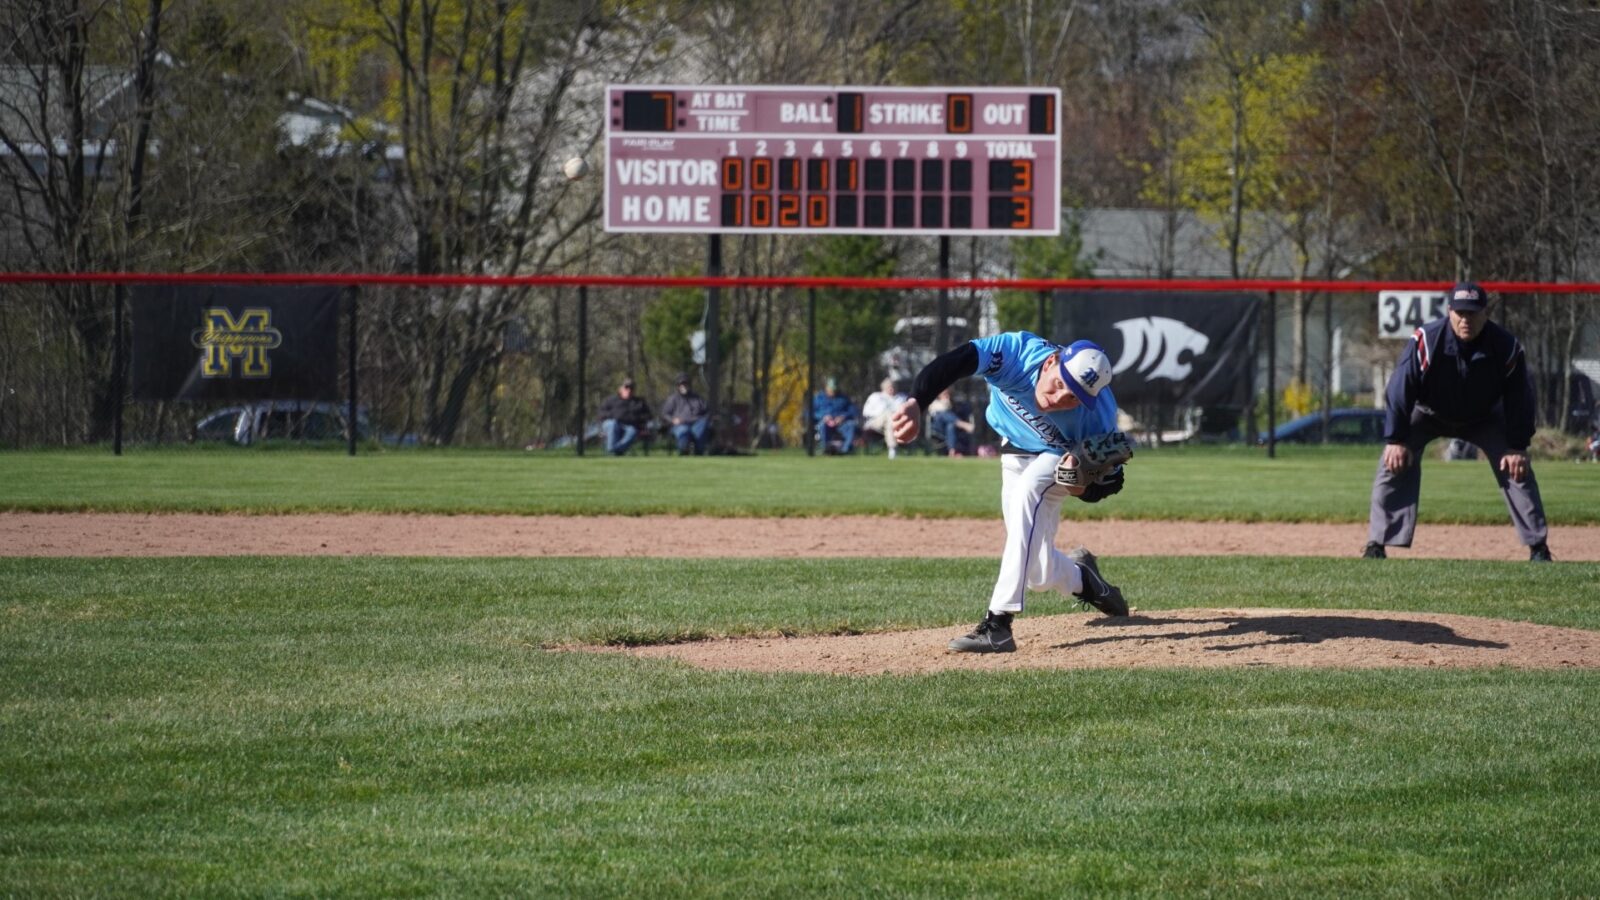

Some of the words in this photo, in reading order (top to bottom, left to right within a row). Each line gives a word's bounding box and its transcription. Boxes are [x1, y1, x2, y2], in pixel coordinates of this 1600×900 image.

[652, 92, 674, 130] 7
[692, 92, 710, 108] AT
[714, 92, 746, 108] BAT
[780, 103, 833, 123] BALL
[869, 103, 944, 124] STRIKE
[949, 94, 972, 133] 0
[983, 104, 1025, 125] OUT
[697, 116, 740, 131] TIME
[728, 140, 738, 156] 1
[755, 140, 767, 156] 2
[784, 140, 796, 157] 3
[812, 141, 824, 157] 4
[841, 141, 853, 157] 5
[869, 141, 882, 157] 6
[898, 142, 909, 157] 7
[927, 142, 939, 158] 8
[955, 142, 968, 158] 9
[985, 142, 1037, 158] TOTAL
[616, 159, 718, 186] VISITOR
[723, 159, 742, 190] 0
[751, 159, 771, 190] 0
[1011, 160, 1032, 192] 3
[622, 194, 711, 222] HOME
[751, 195, 771, 226] 0
[780, 195, 799, 226] 2
[808, 195, 828, 226] 0
[1011, 197, 1032, 228] 3
[1383, 296, 1444, 333] 345
[202, 307, 271, 377] M
